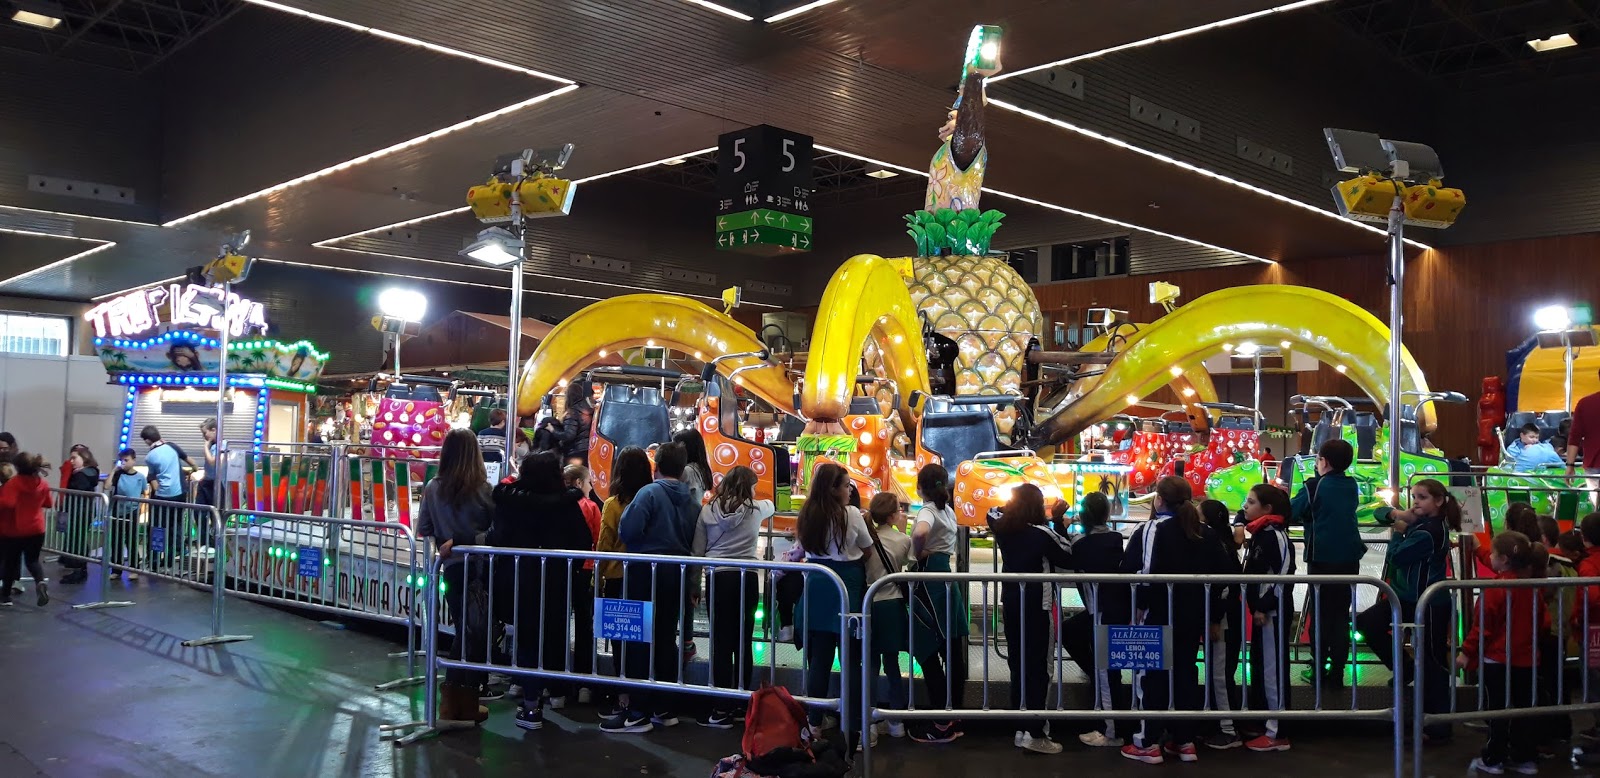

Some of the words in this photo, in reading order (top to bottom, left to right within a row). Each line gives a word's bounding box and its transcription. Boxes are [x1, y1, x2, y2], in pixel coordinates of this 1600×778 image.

[733, 138, 746, 173] 5
[782, 138, 796, 173] 5
[719, 200, 724, 210] 3
[776, 195, 782, 206] 3
[338, 571, 390, 612] MAXIMA
[604, 604, 641, 614] ALKIZABAL
[603, 622, 615, 631] 946
[616, 623, 629, 632] 314
[629, 624, 642, 633] 406
[1111, 630, 1160, 639] ALKIZABAL
[1110, 651, 1126, 660] 946
[1128, 651, 1143, 660] 314
[1144, 651, 1160, 660] 406
